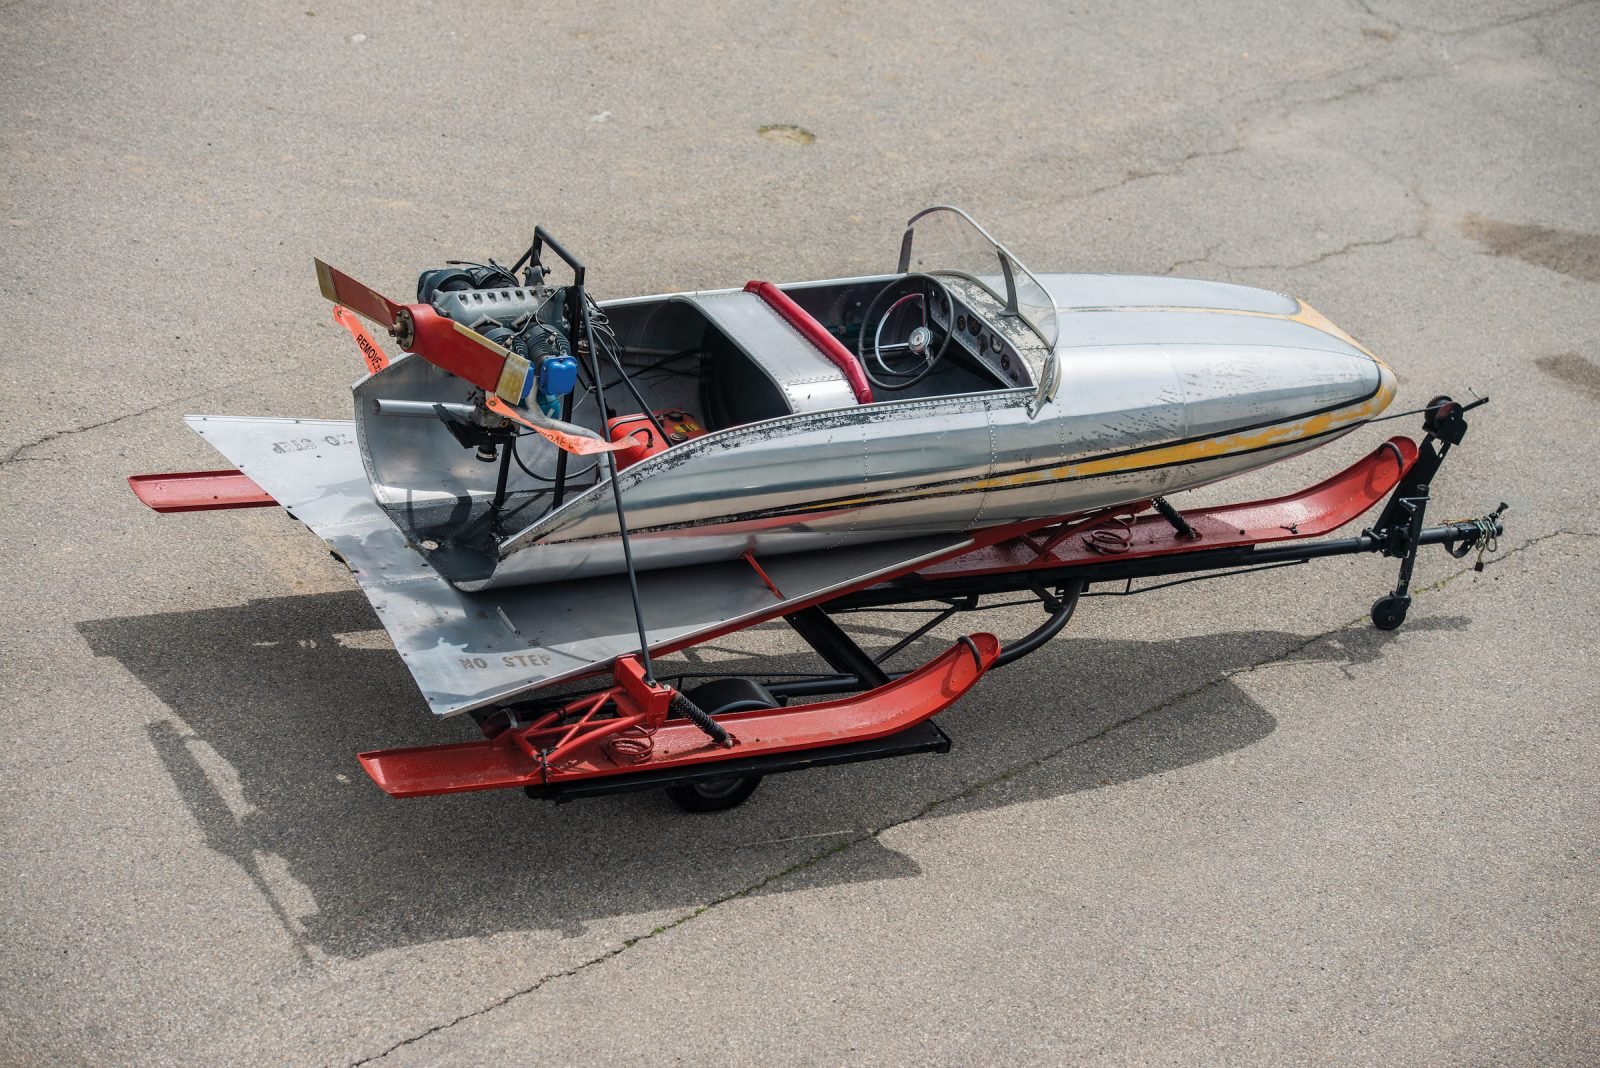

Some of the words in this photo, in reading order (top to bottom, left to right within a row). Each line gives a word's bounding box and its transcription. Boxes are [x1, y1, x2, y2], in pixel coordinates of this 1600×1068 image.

[355, 334, 382, 368] REMOVE
[459, 657, 488, 669] NO
[502, 654, 550, 667] STEP
